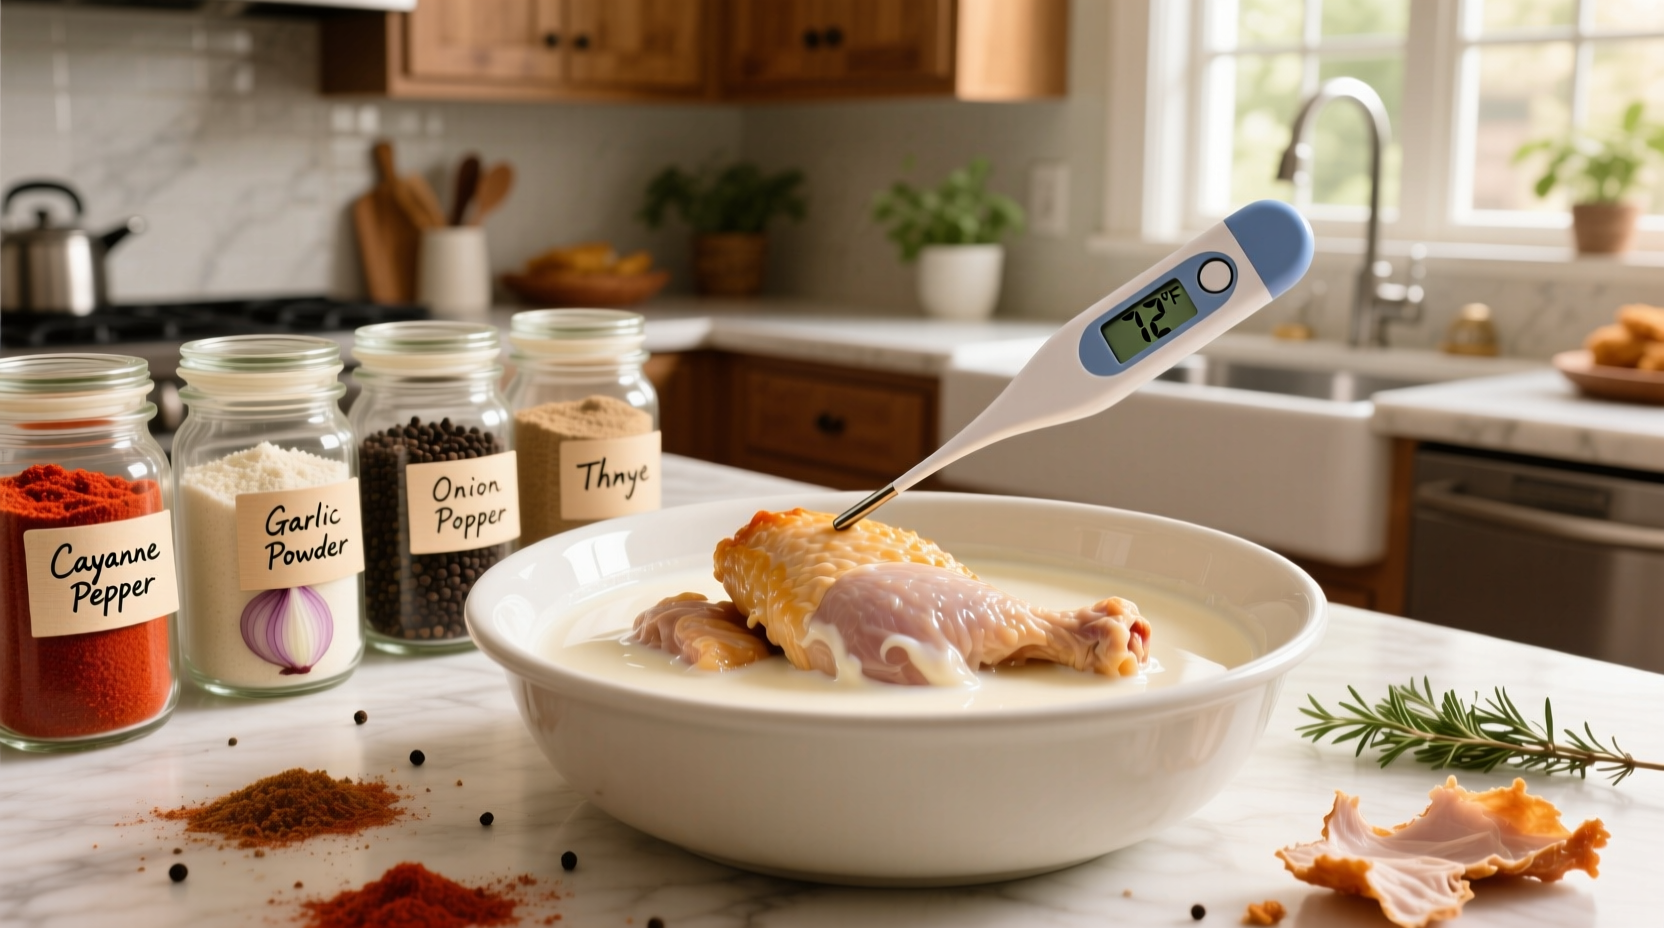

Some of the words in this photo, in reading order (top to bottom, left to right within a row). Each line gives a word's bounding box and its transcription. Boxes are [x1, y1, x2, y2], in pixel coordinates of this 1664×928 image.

[432, 476, 502, 502] Onion
[576, 457, 650, 500] Thnye
[265, 501, 341, 537] Garlic
[435, 507, 507, 539] Popper
[50, 542, 161, 586] Cayanne
[265, 533, 349, 571] Powder
[70, 576, 156, 617] Pepper
